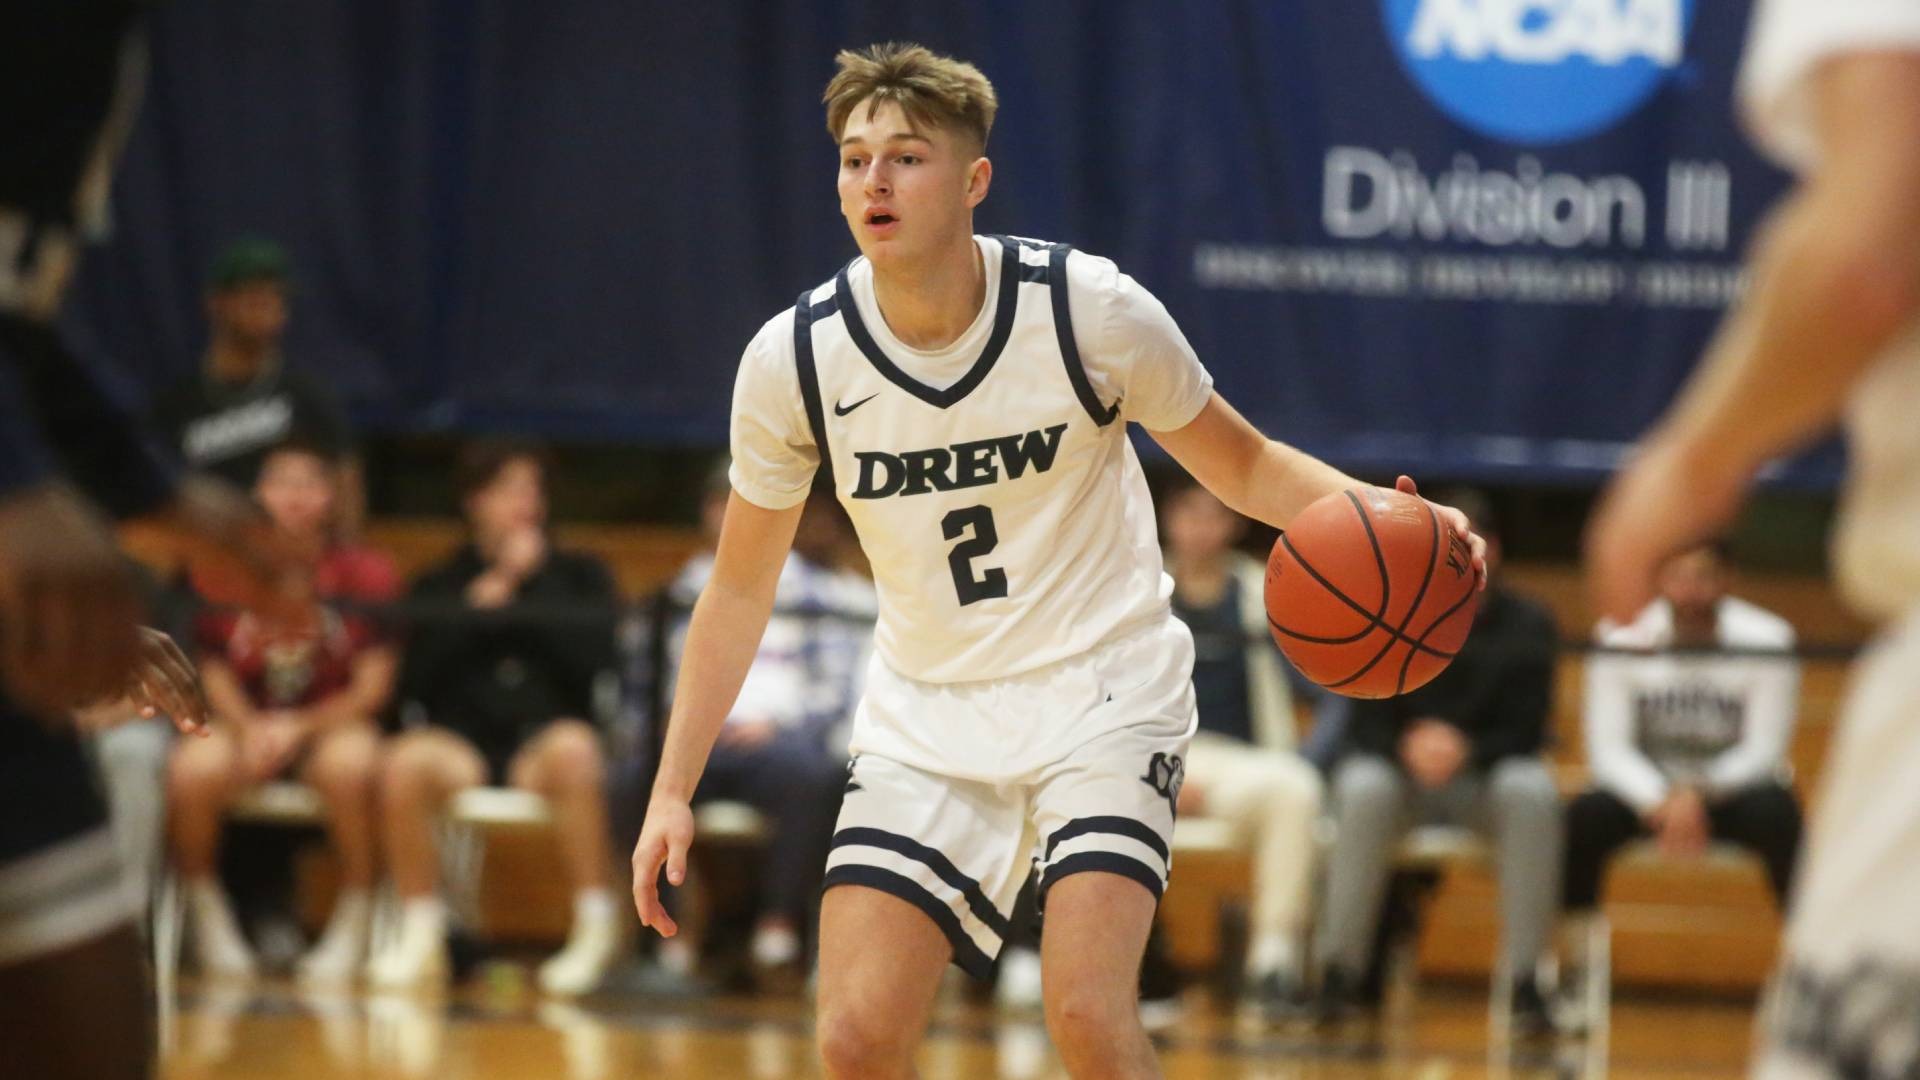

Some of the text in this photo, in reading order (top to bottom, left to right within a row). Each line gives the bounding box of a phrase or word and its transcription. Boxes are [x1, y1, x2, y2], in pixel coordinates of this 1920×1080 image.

[1404, 0, 1683, 66] NCAA
[1324, 147, 1731, 250] Division III
[851, 423, 1068, 499] DREW
[941, 504, 1008, 607] 2
